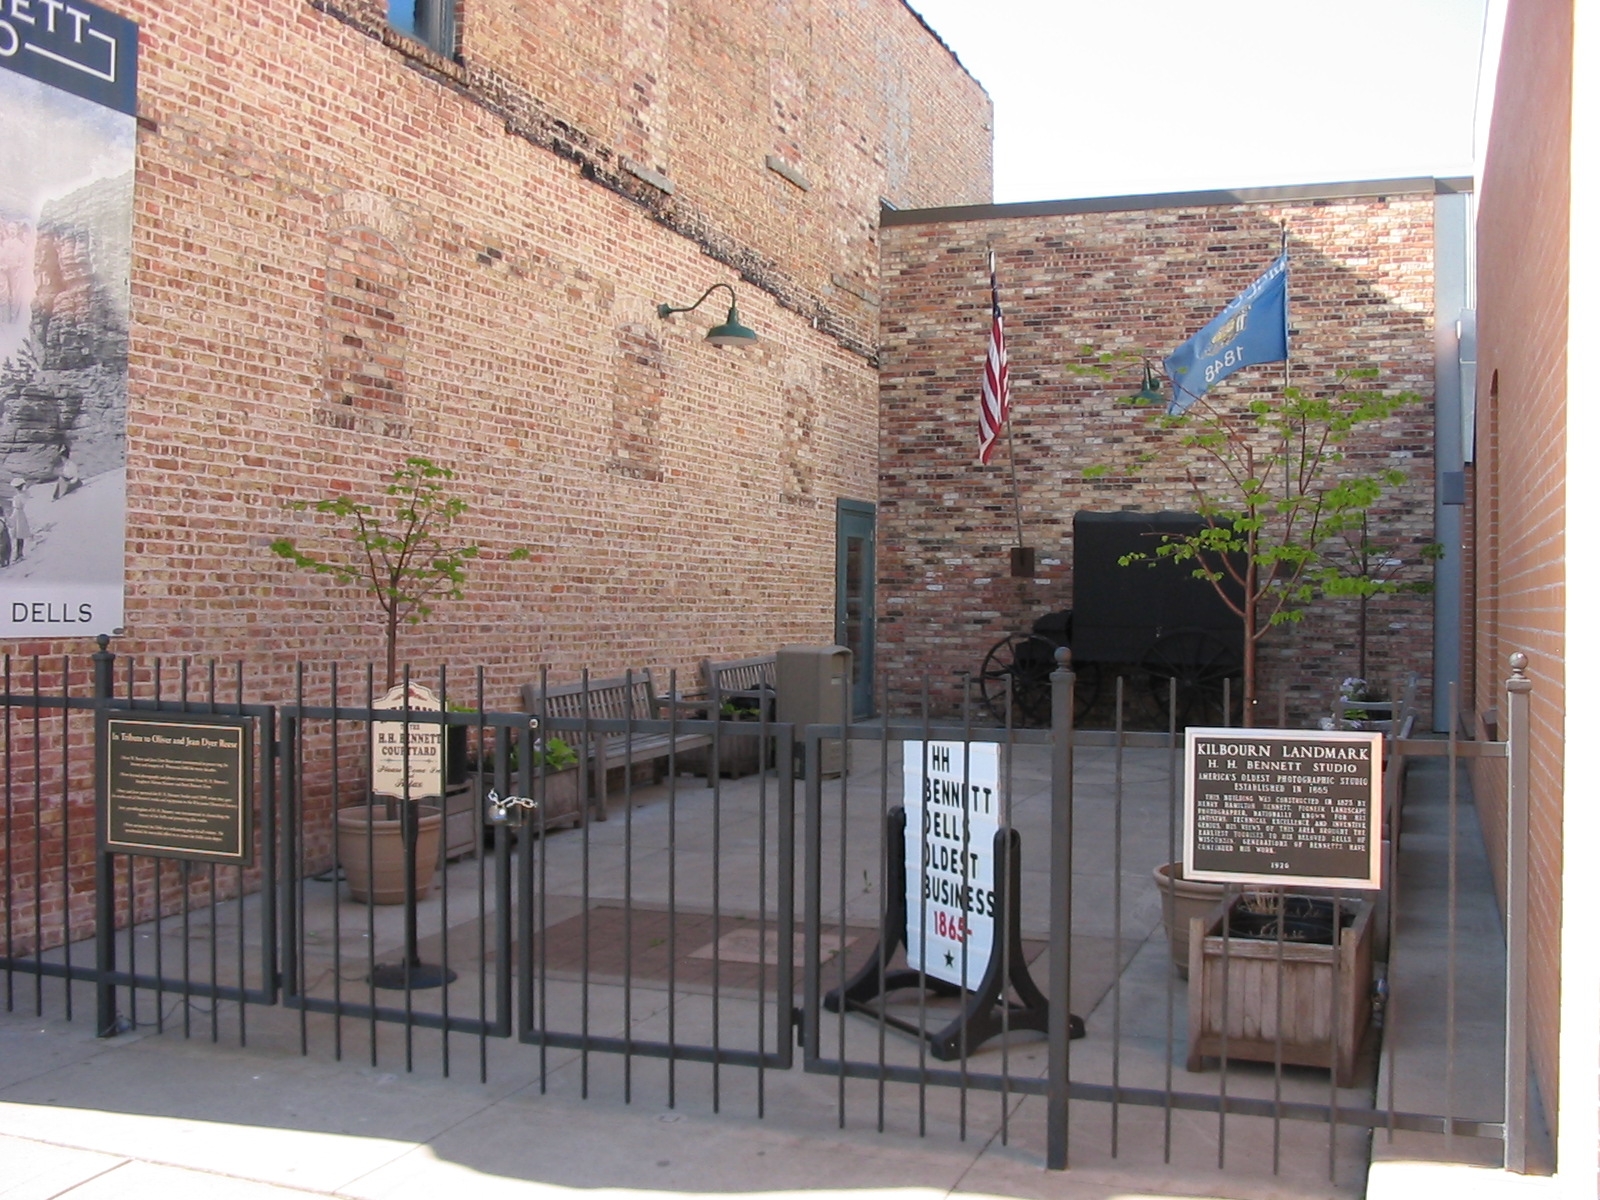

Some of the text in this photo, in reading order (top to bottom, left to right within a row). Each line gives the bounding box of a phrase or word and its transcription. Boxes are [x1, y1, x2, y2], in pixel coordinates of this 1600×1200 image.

[0, 0, 91, 43] ETT
[12, 603, 93, 623] DELLS
[151, 735, 172, 744] Oliver
[173, 737, 185, 745] and
[185, 737, 200, 747] Jean
[201, 738, 217, 749] Dyer
[378, 733, 396, 743] H.H.
[1197, 743, 1368, 759] KILBOURN LANDMARK
[932, 745, 949, 772] HH
[1247, 760, 1301, 770] BENNETT
[1312, 762, 1356, 772] STUDIO
[1198, 772, 1367, 785] AMERICA'S OLDEST PHOTOGRAPHIC STUDIO
[1234, 783, 1285, 792] ESTABLISHED
